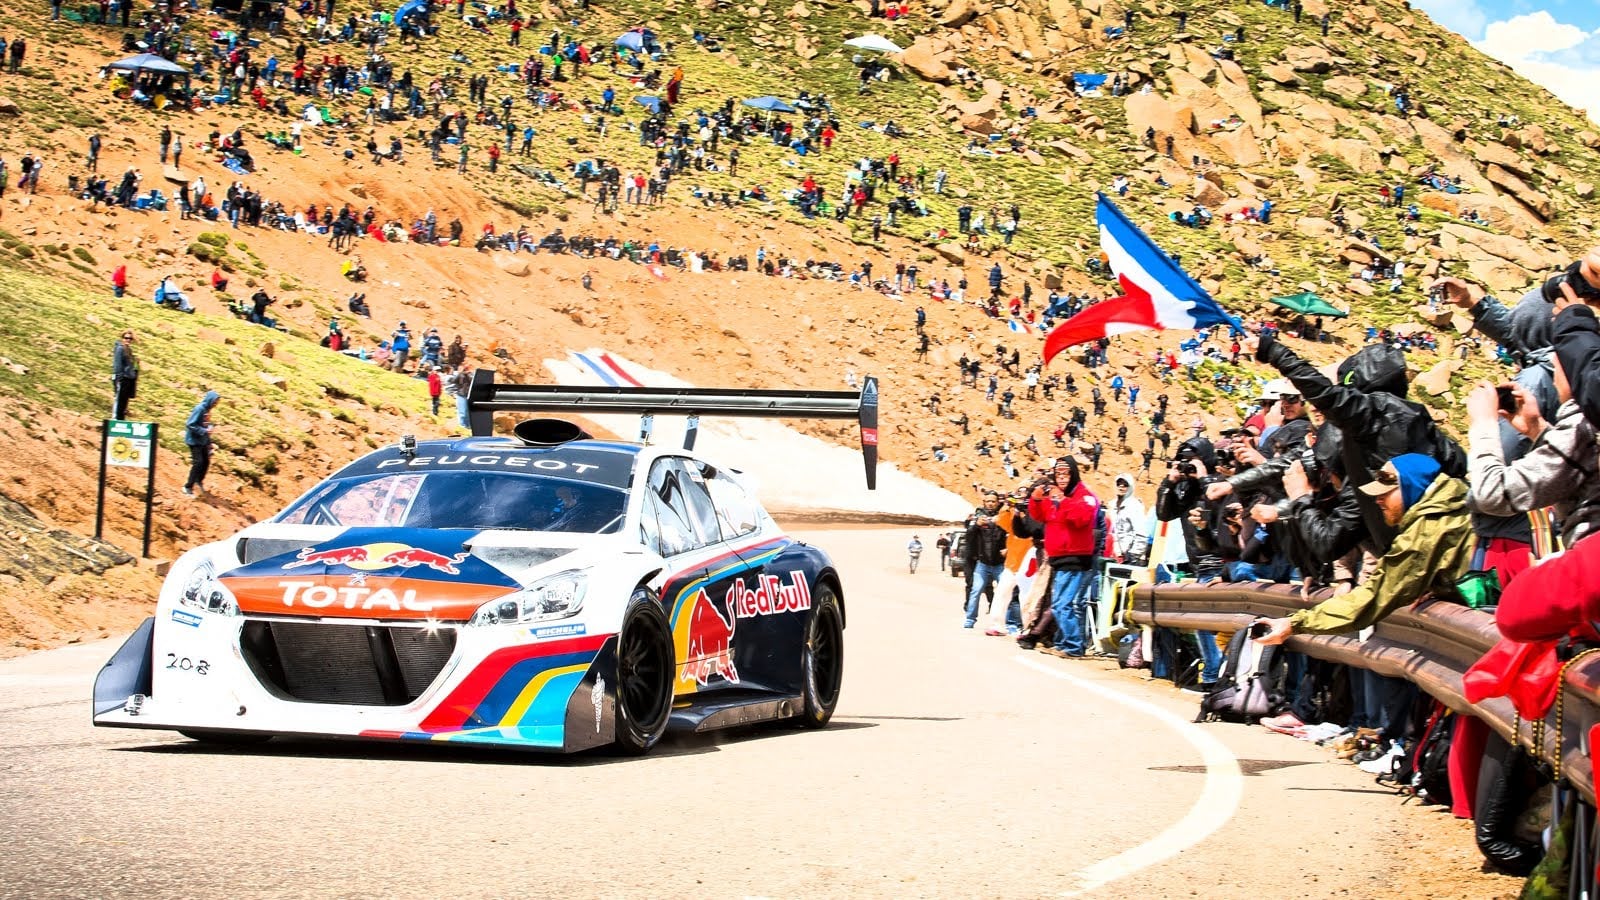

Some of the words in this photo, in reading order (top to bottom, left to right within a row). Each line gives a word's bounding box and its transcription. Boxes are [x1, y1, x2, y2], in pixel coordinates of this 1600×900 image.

[376, 455, 600, 474] PEUGEOT
[278, 581, 433, 612] TOTAL
[736, 574, 773, 618] Red
[765, 570, 811, 614] Bull
[536, 624, 585, 636] MICHELIN
[166, 653, 211, 676] 208
